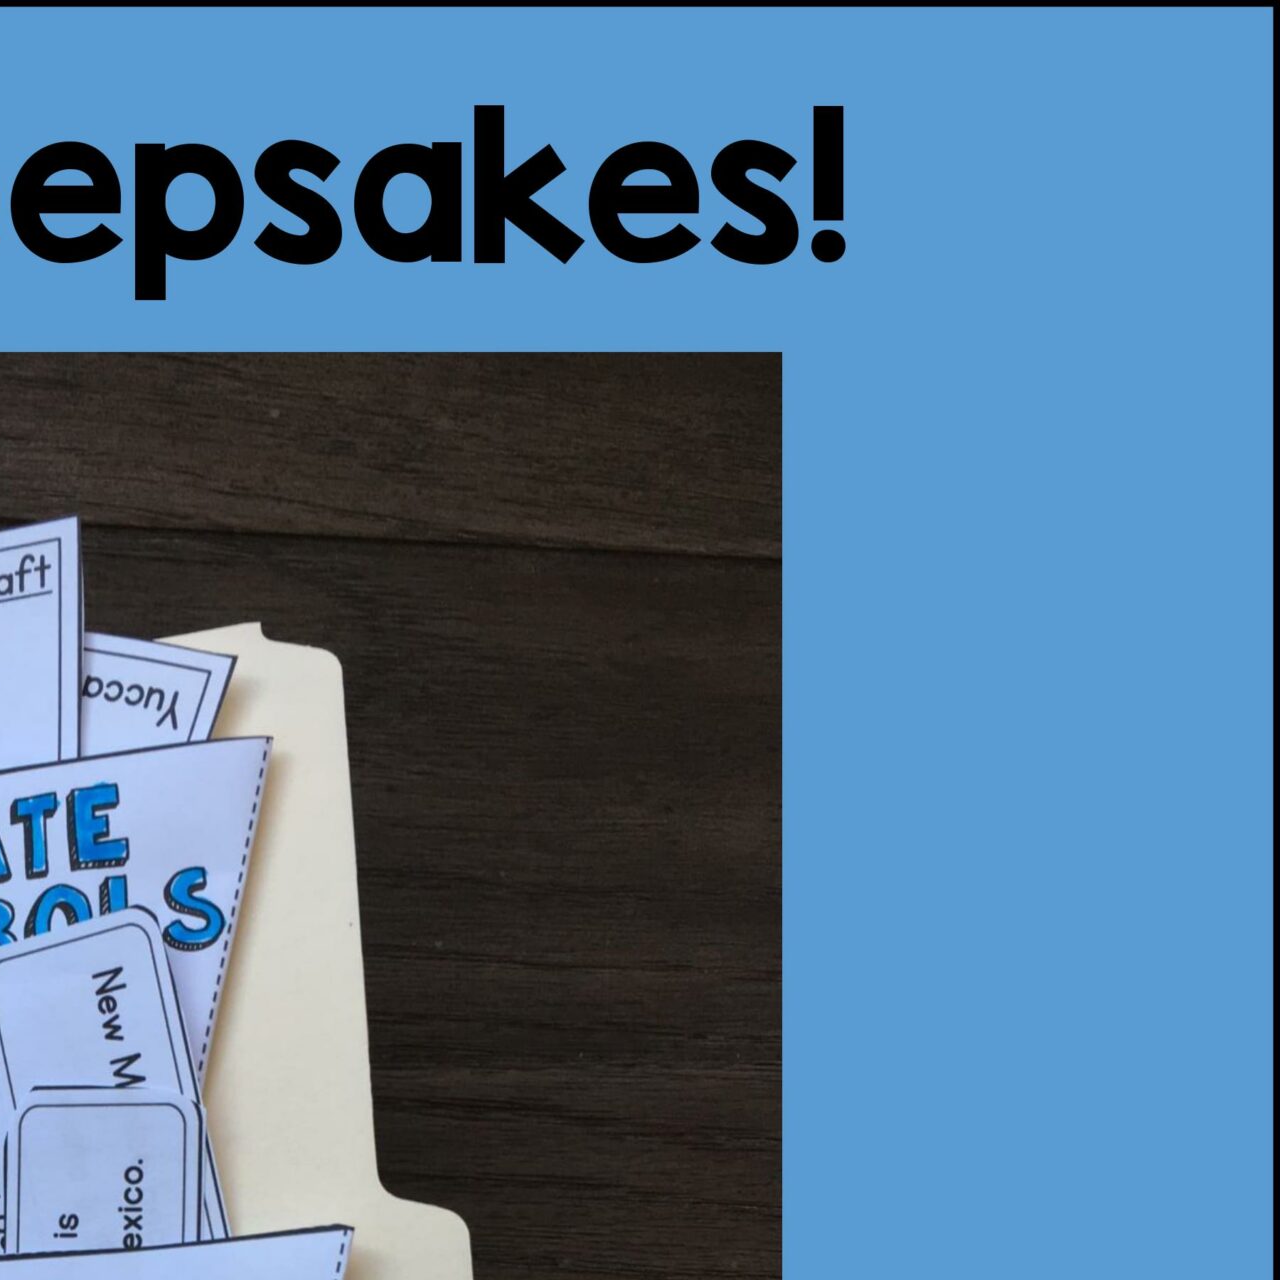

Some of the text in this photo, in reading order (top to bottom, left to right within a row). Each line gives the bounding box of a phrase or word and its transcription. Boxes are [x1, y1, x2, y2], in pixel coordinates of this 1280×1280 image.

[81, 673, 180, 731] Yucca
[91, 966, 127, 1041] New
[53, 1212, 80, 1239] is
